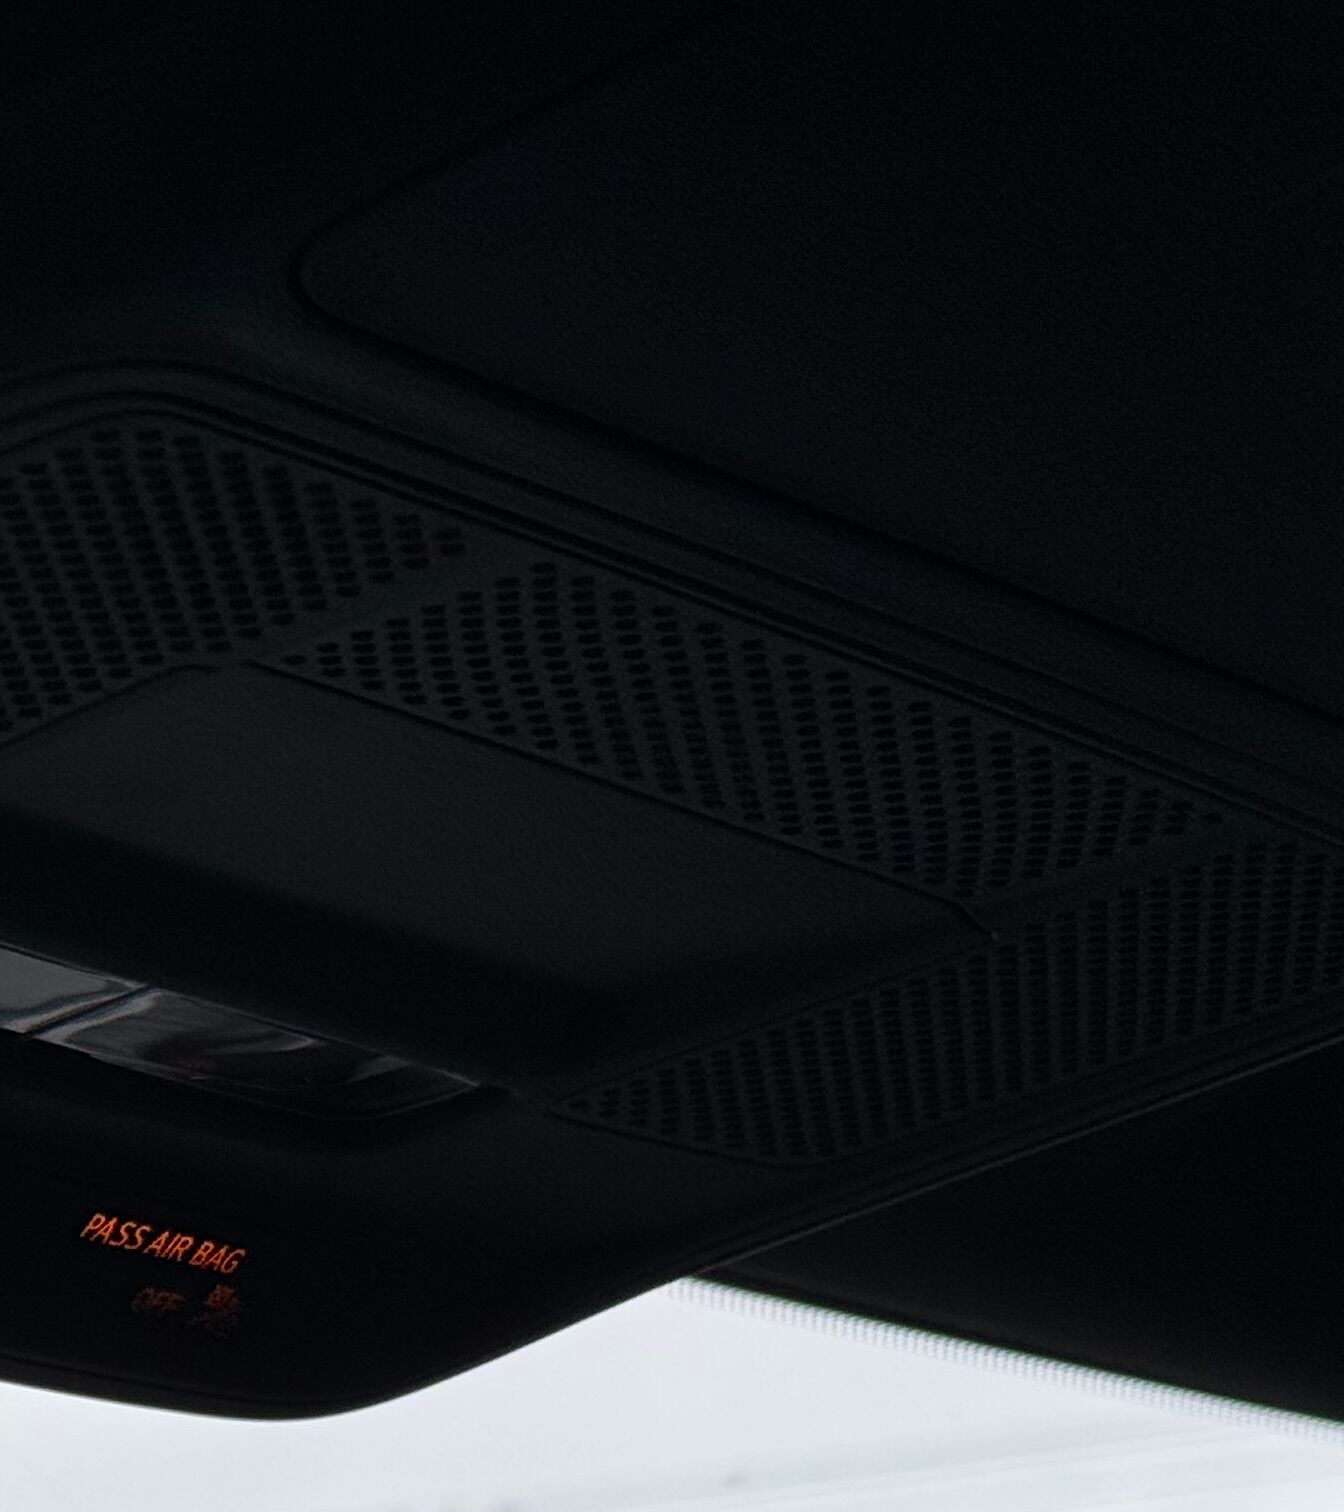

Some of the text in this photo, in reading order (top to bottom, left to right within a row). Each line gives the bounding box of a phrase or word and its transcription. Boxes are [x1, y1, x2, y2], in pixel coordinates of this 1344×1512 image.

[79, 1212, 247, 1274] PASS AIR BAG
